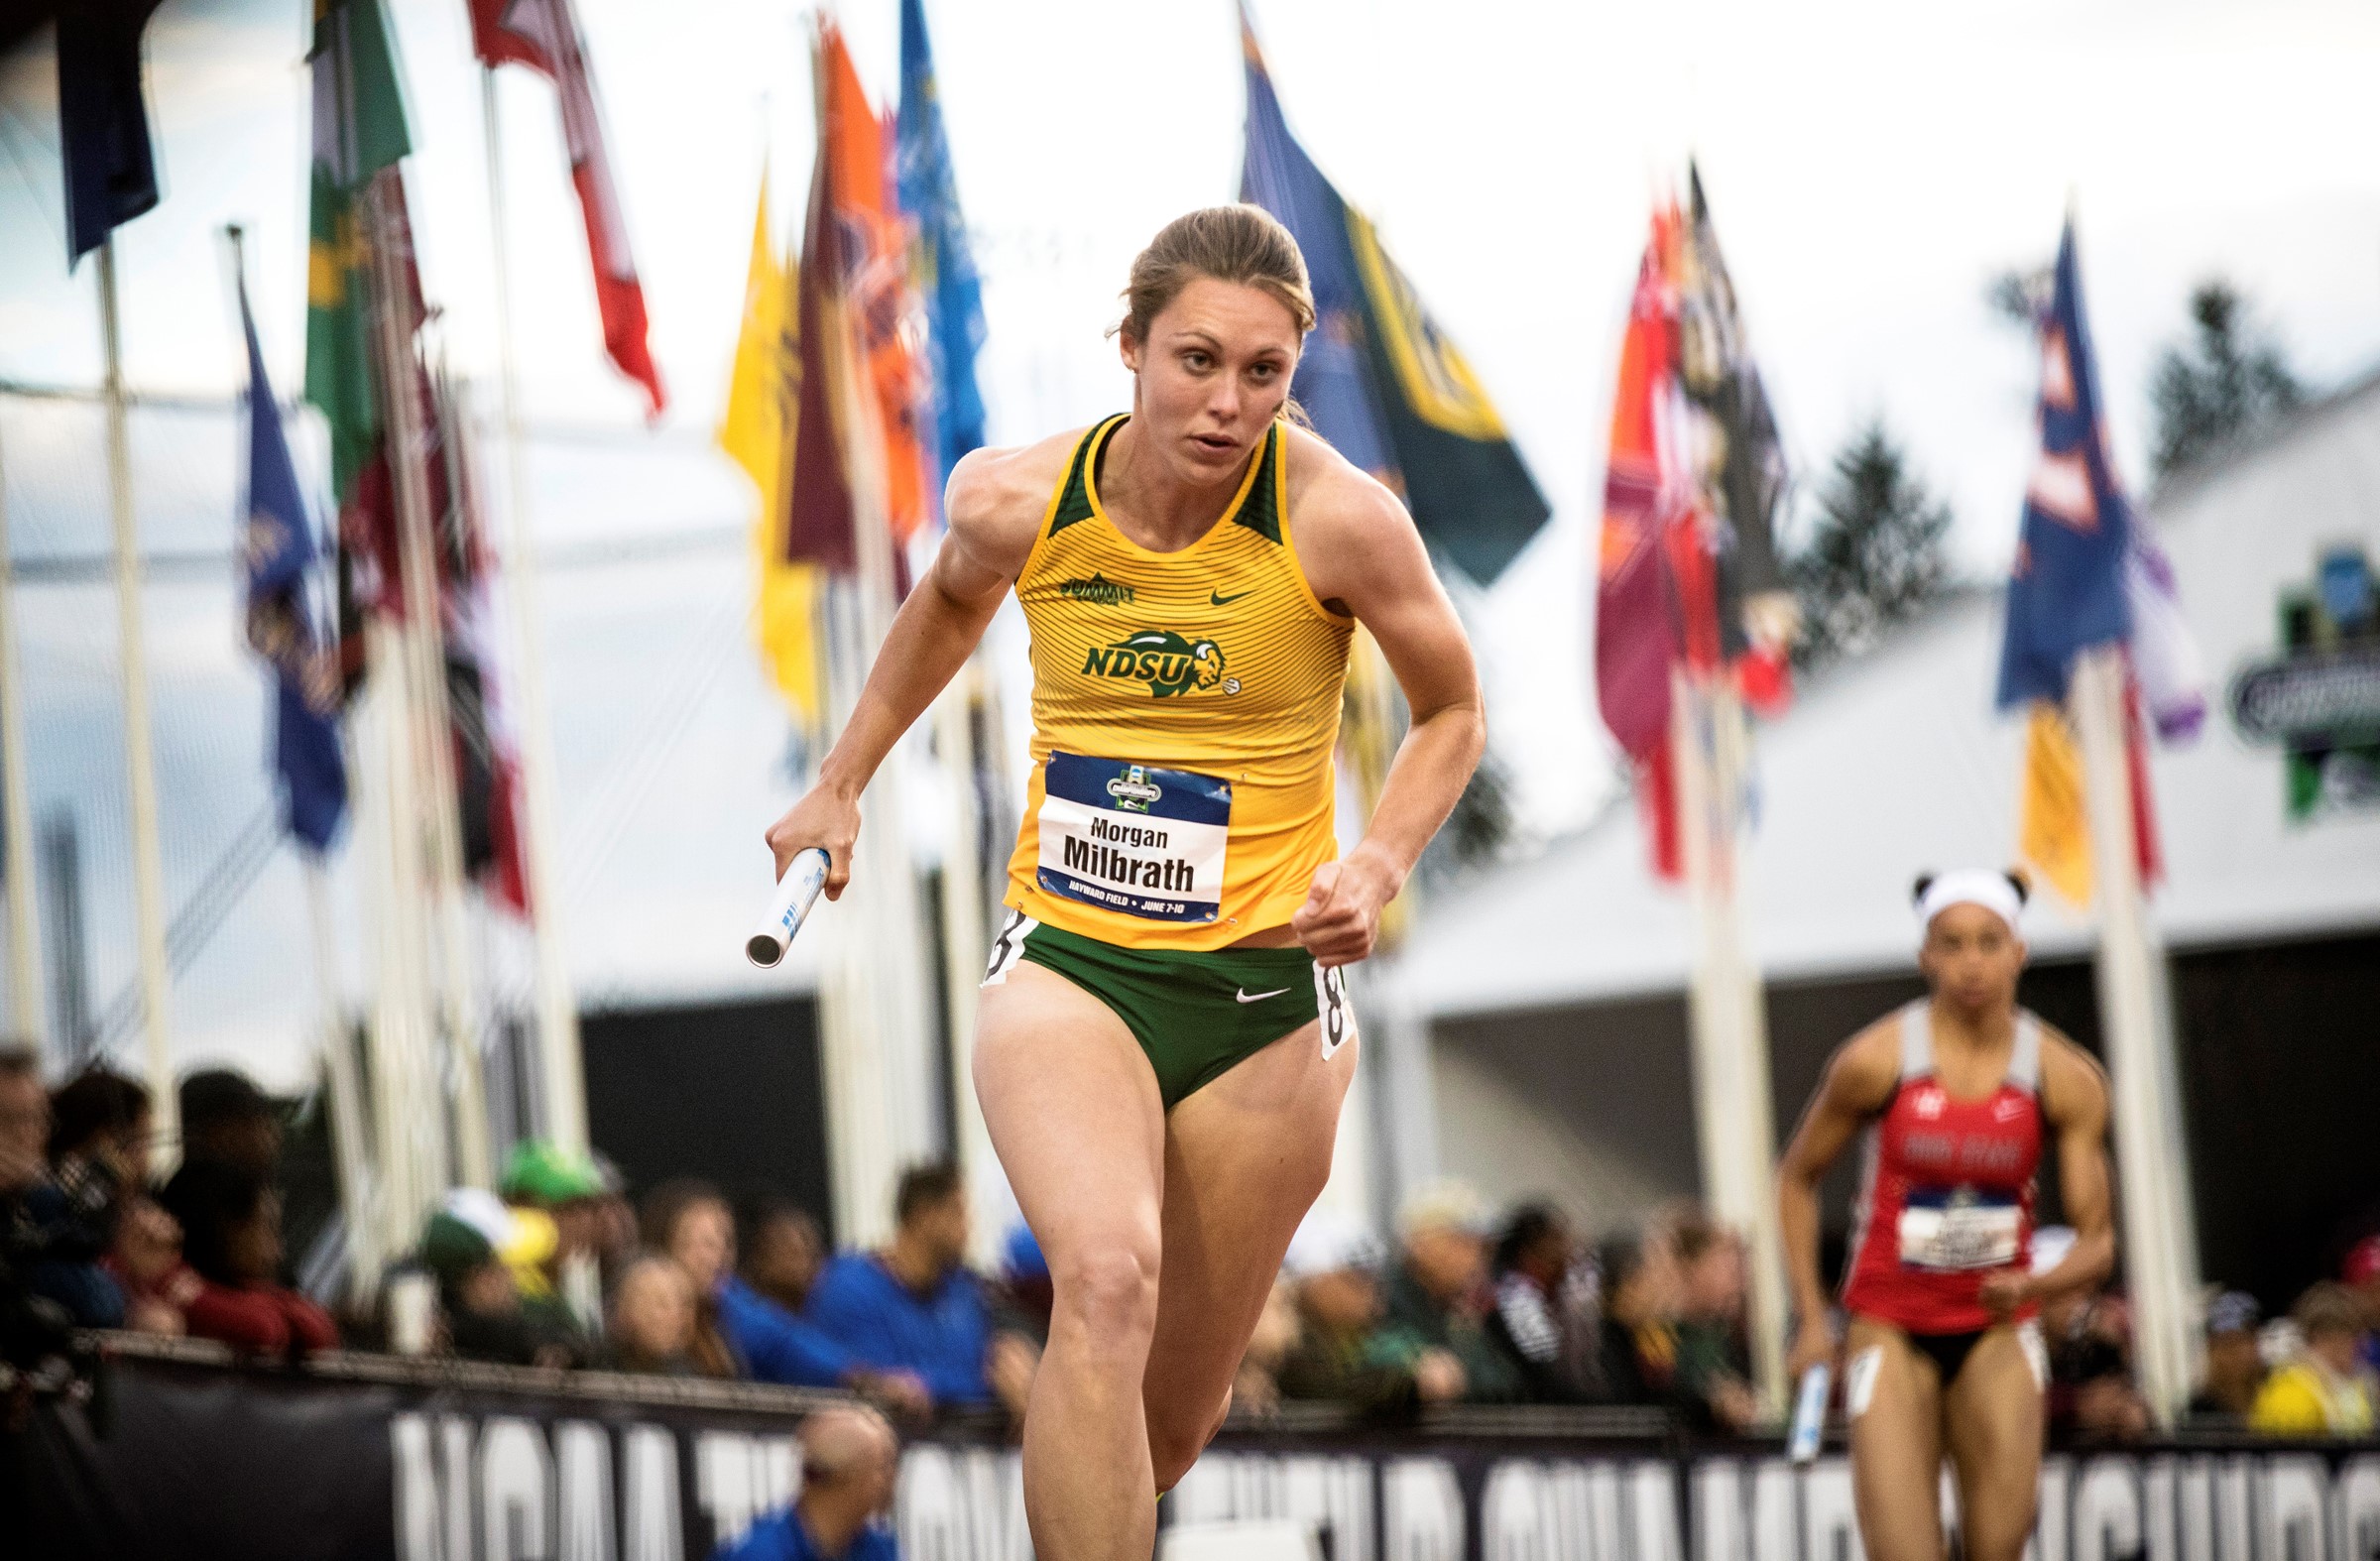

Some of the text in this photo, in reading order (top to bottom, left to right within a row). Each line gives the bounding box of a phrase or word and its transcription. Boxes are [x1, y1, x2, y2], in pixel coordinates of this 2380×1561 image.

[1081, 648, 1190, 682] NDSU
[1091, 816, 1168, 849] Morgan
[1064, 834, 1194, 893] Milbrath
[1068, 880, 1106, 901] HAYWARD
[1106, 893, 1129, 906] FIELD
[1140, 901, 1165, 912] JUNE
[1166, 903, 1185, 914] 7-10
